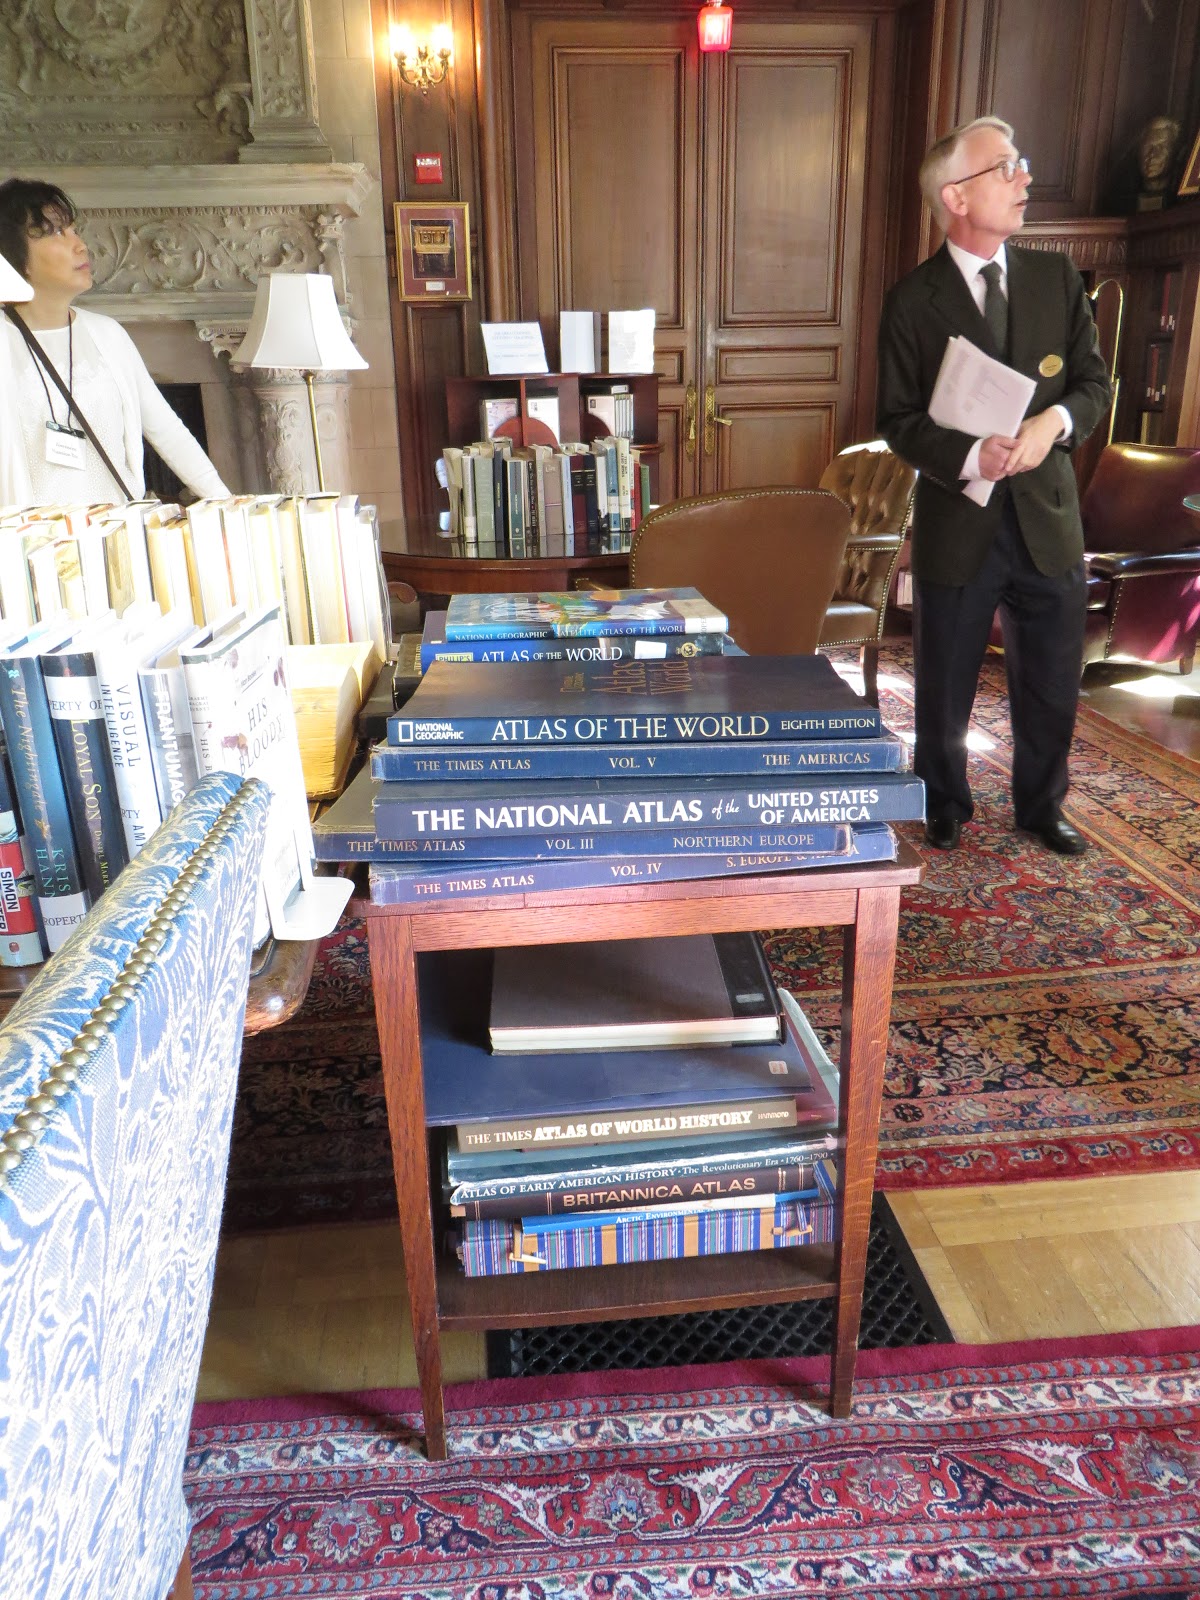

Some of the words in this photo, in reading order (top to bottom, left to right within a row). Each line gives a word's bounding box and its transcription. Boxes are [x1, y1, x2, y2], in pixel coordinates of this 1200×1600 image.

[704, 13, 732, 45] EXIT
[497, 631, 548, 639] GEOGRAPHIC
[600, 627, 624, 635] ATLAS
[626, 626, 637, 634] OF
[640, 625, 656, 634] THE
[659, 624, 685, 633] WORL
[481, 650, 530, 662] ATLAS
[533, 652, 543, 660] OF
[546, 651, 562, 661] THE
[566, 646, 623, 662] WORLD
[11, 688, 29, 718] The
[248, 697, 268, 732] HIS
[100, 684, 124, 768] INTELLIGENCE
[116, 683, 141, 768] VISUAL
[415, 722, 454, 732] NATIONAL
[415, 730, 464, 740] GEOGRAPHIC
[491, 719, 567, 741] ATLAS
[574, 718, 608, 739] OF
[614, 717, 667, 739] THE
[674, 715, 769, 738] WORLD
[781, 718, 825, 730] EIGHTH
[829, 717, 876, 729] EDITION
[70, 719, 94, 778] LOYAL
[82, 783, 102, 820] SON
[414, 760, 440, 771] THE
[445, 759, 484, 771] TIMES
[490, 758, 531, 770] ATLAS
[609, 757, 640, 769] VOL.
[647, 756, 657, 768] V
[763, 754, 791, 766] THE
[798, 752, 870, 765] AMERICAS
[748, 792, 814, 809] UNITED
[820, 789, 879, 804] STATES
[412, 808, 465, 832] THE
[475, 803, 612, 830] NATIONAL
[623, 800, 703, 824] ATLAS
[711, 800, 722, 820] of
[724, 798, 740, 814] the
[760, 809, 785, 825] OF
[791, 806, 871, 823] AMERICA
[347, 840, 375, 852] THE
[379, 840, 418, 852] TIMES
[424, 839, 466, 852] ATLAS
[580, 838, 594, 849] III
[673, 835, 753, 849] NORTHERN
[760, 833, 814, 847] EUROPE
[51, 848, 72, 895] KRIS
[414, 883, 442, 895] THE
[447, 879, 487, 892] TIMES
[491, 874, 535, 888] ATLAS
[647, 863, 662, 875] IV
[0, 870, 18, 911] SIMON
[466, 1133, 492, 1145] THE
[494, 1130, 532, 1143] TIMES
[532, 1124, 587, 1141] ATLAS
[590, 1121, 613, 1137] OF
[613, 1116, 677, 1135] WORLD
[679, 1110, 753, 1129] HISTORY
[757, 1111, 789, 1119] HAMMOND
[461, 1186, 497, 1199] ATLAS
[500, 1185, 516, 1195] OF
[519, 1181, 557, 1193] EARLY
[558, 1173, 622, 1189] AMERICAN
[625, 1168, 677, 1182] HISTORY
[682, 1166, 699, 1175] The
[702, 1160, 762, 1173] Revolutionary
[765, 1158, 779, 1166] Era
[563, 1184, 684, 1207] BRITANNICA
[690, 1177, 756, 1195] ATLAS
[616, 1214, 644, 1223] ARCTIC
